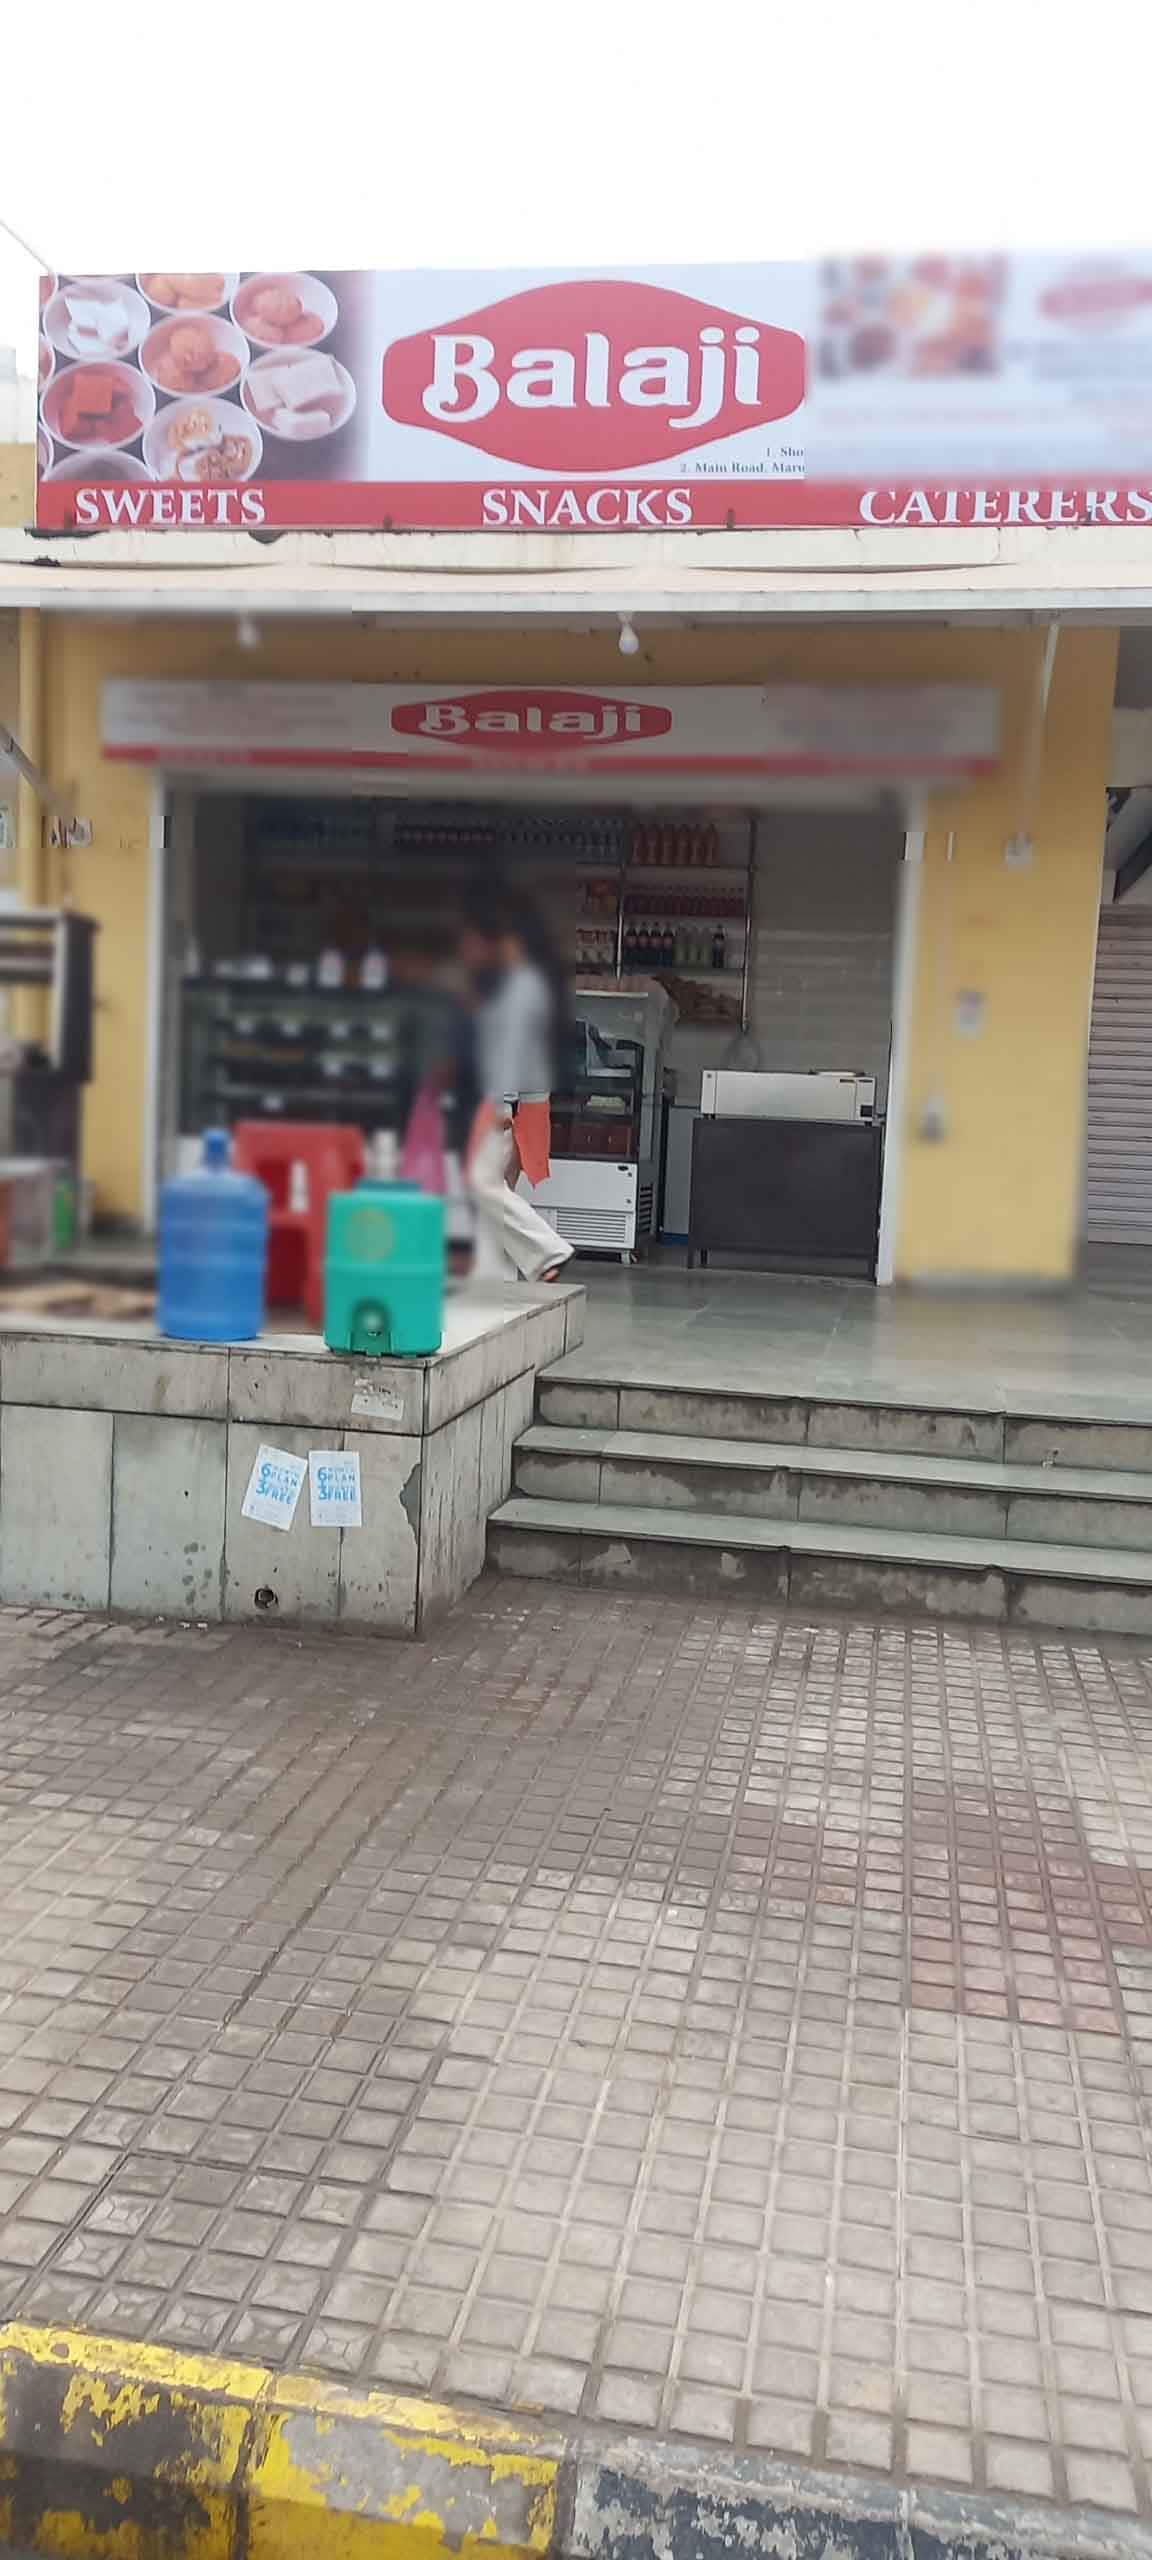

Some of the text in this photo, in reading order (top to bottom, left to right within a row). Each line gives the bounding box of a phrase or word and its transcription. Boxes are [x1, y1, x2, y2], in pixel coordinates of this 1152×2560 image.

[422, 326, 761, 429] Balaji
[696, 463, 727, 473] Main
[780, 446, 807, 457] Sho
[75, 488, 265, 525] SWEETS
[482, 487, 693, 525] SNACKS
[859, 489, 1152, 524] CATERERS
[418, 703, 641, 740] Balaji
